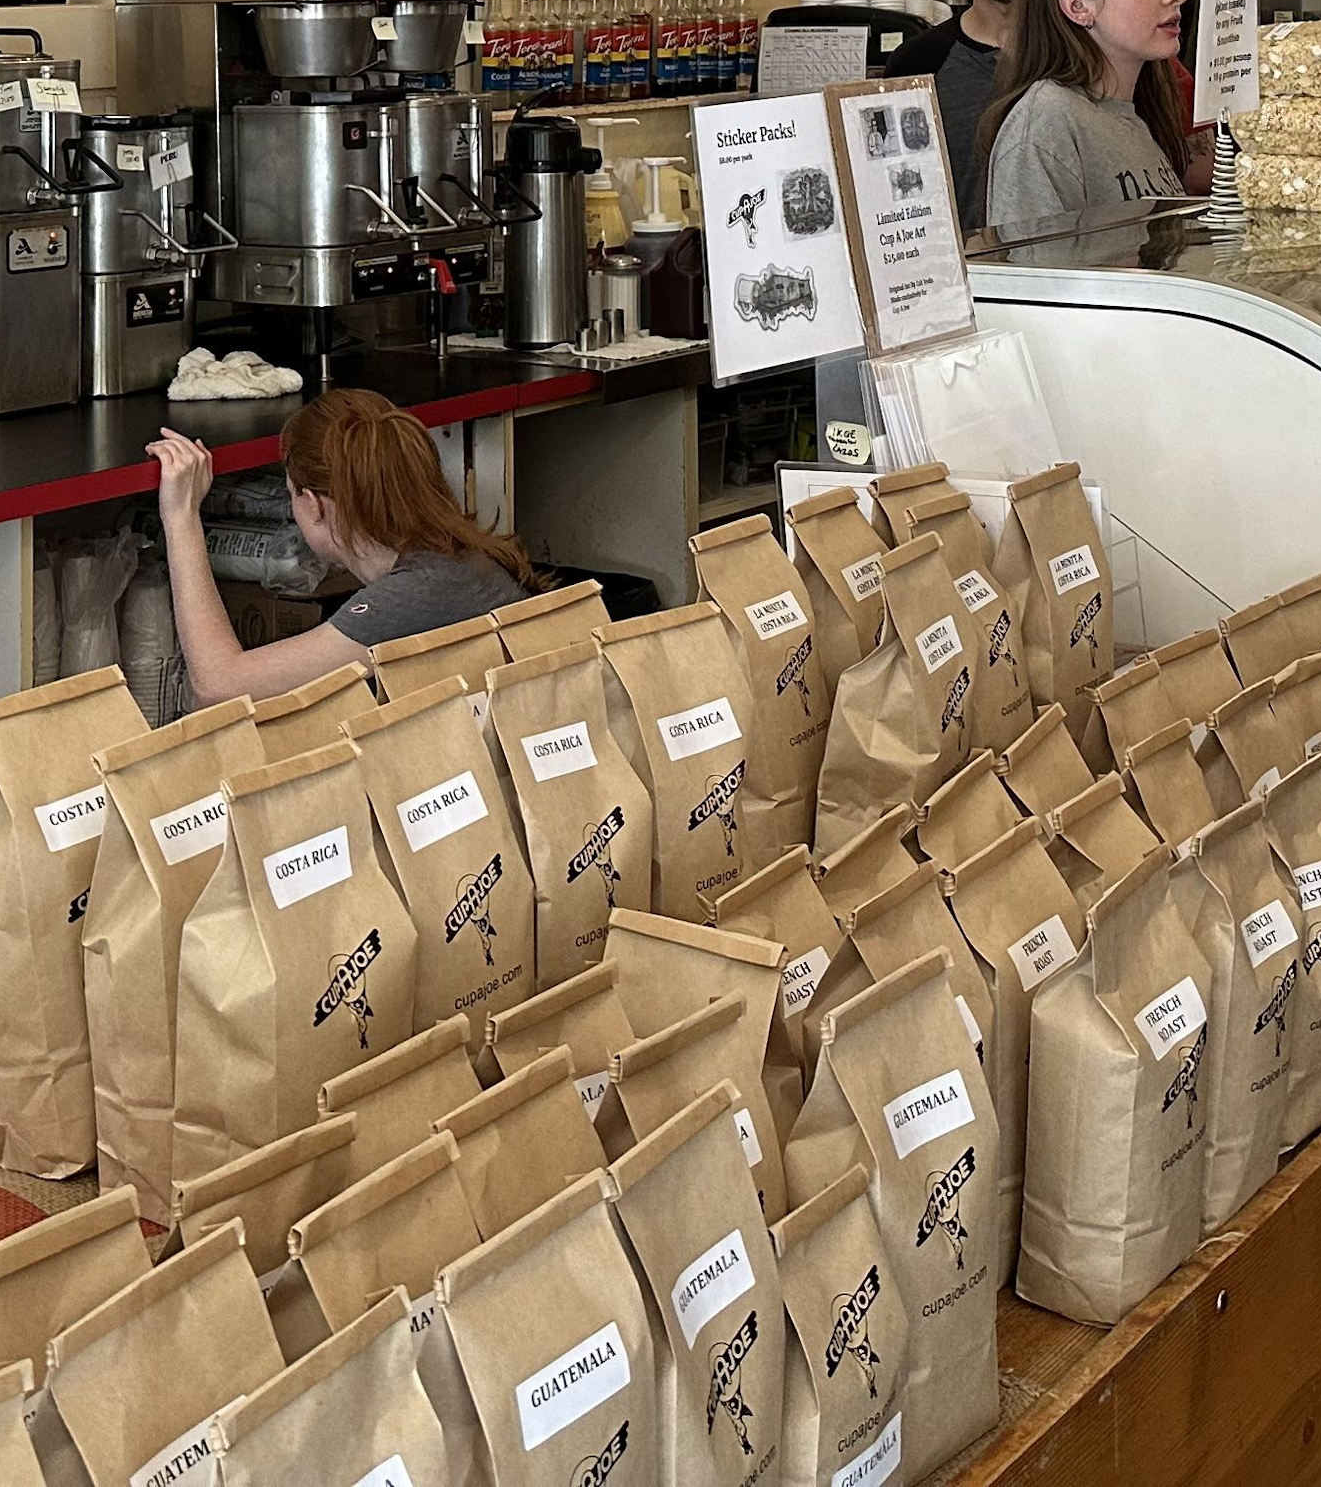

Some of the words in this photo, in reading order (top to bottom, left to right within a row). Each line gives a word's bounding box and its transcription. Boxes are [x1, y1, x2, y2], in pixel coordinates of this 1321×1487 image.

[716, 126, 758, 149] Sticker
[760, 119, 797, 144] Packs!
[880, 233, 894, 247] Cup
[896, 231, 902, 241] A
[902, 229, 914, 244] Joe
[915, 227, 926, 239] Art
[669, 714, 698, 738] COSTA
[700, 708, 725, 729] RICA
[534, 742, 561, 759] COSTA
[562, 734, 583, 752] RICA
[49, 800, 93, 828] COSTA
[406, 795, 440, 825] COSTA
[442, 784, 470, 812] RICA
[274, 852, 310, 882] COSTA
[313, 842, 341, 869] RICA
[1246, 911, 1273, 939] FRENCH
[1022, 931, 1048, 958] FRENCH
[1034, 950, 1055, 973] ROAST
[454, 963, 524, 1011] cupajoe.com
[1145, 994, 1182, 1027] FRENCH
[1158, 1014, 1188, 1045] ROAST
[893, 1086, 959, 1130] GUATEMALA
[677, 1248, 740, 1314] GUATEMALA
[923, 1265, 988, 1318] cupajoe.com
[530, 1341, 617, 1409] GUATEMALA
